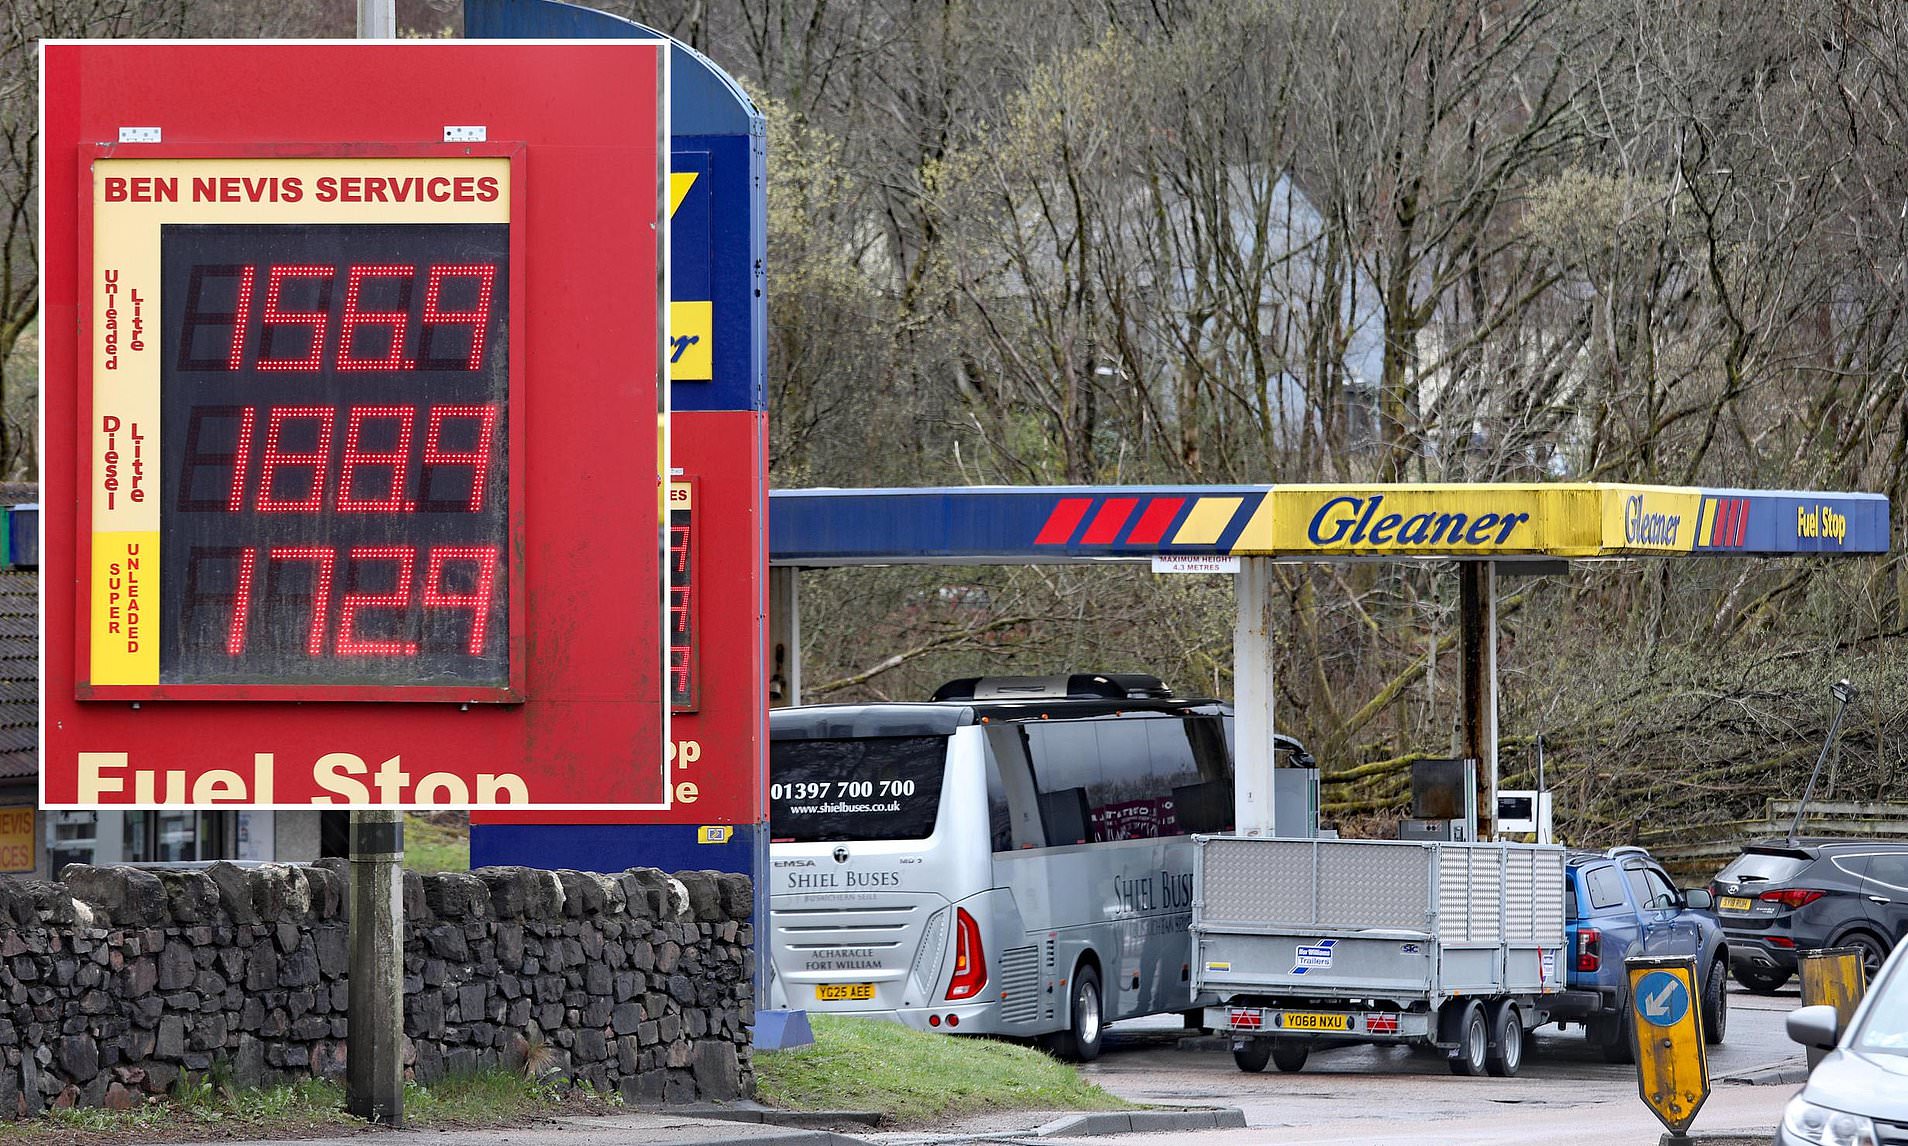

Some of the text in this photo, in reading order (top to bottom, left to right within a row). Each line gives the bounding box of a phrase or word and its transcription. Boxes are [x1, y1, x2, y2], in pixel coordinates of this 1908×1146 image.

[104, 176, 499, 203] BEN NEVIS SERVICES
[105, 270, 118, 370] Unleaded
[131, 289, 144, 351] Litre
[103, 416, 121, 510] Diesel
[131, 423, 144, 502] Litre
[1307, 495, 1530, 545] Gleaner
[1624, 495, 1680, 546] Gleaner
[1797, 505, 1846, 544] Fuel Stop
[109, 563, 120, 633] SUPER
[128, 544, 139, 653] UNLEADED
[77, 752, 274, 804] Fuel
[770, 779, 915, 800] 01397 700 700
[790, 801, 901, 814] www.shielbuses.co.uk
[806, 960, 882, 970] FORT WILLIAM
[812, 949, 874, 958] ACHARACLE
[1299, 957, 1330, 965] Trailers
[820, 986, 870, 998] YG25 AEE
[1320, 1016, 1342, 1027] NXU
